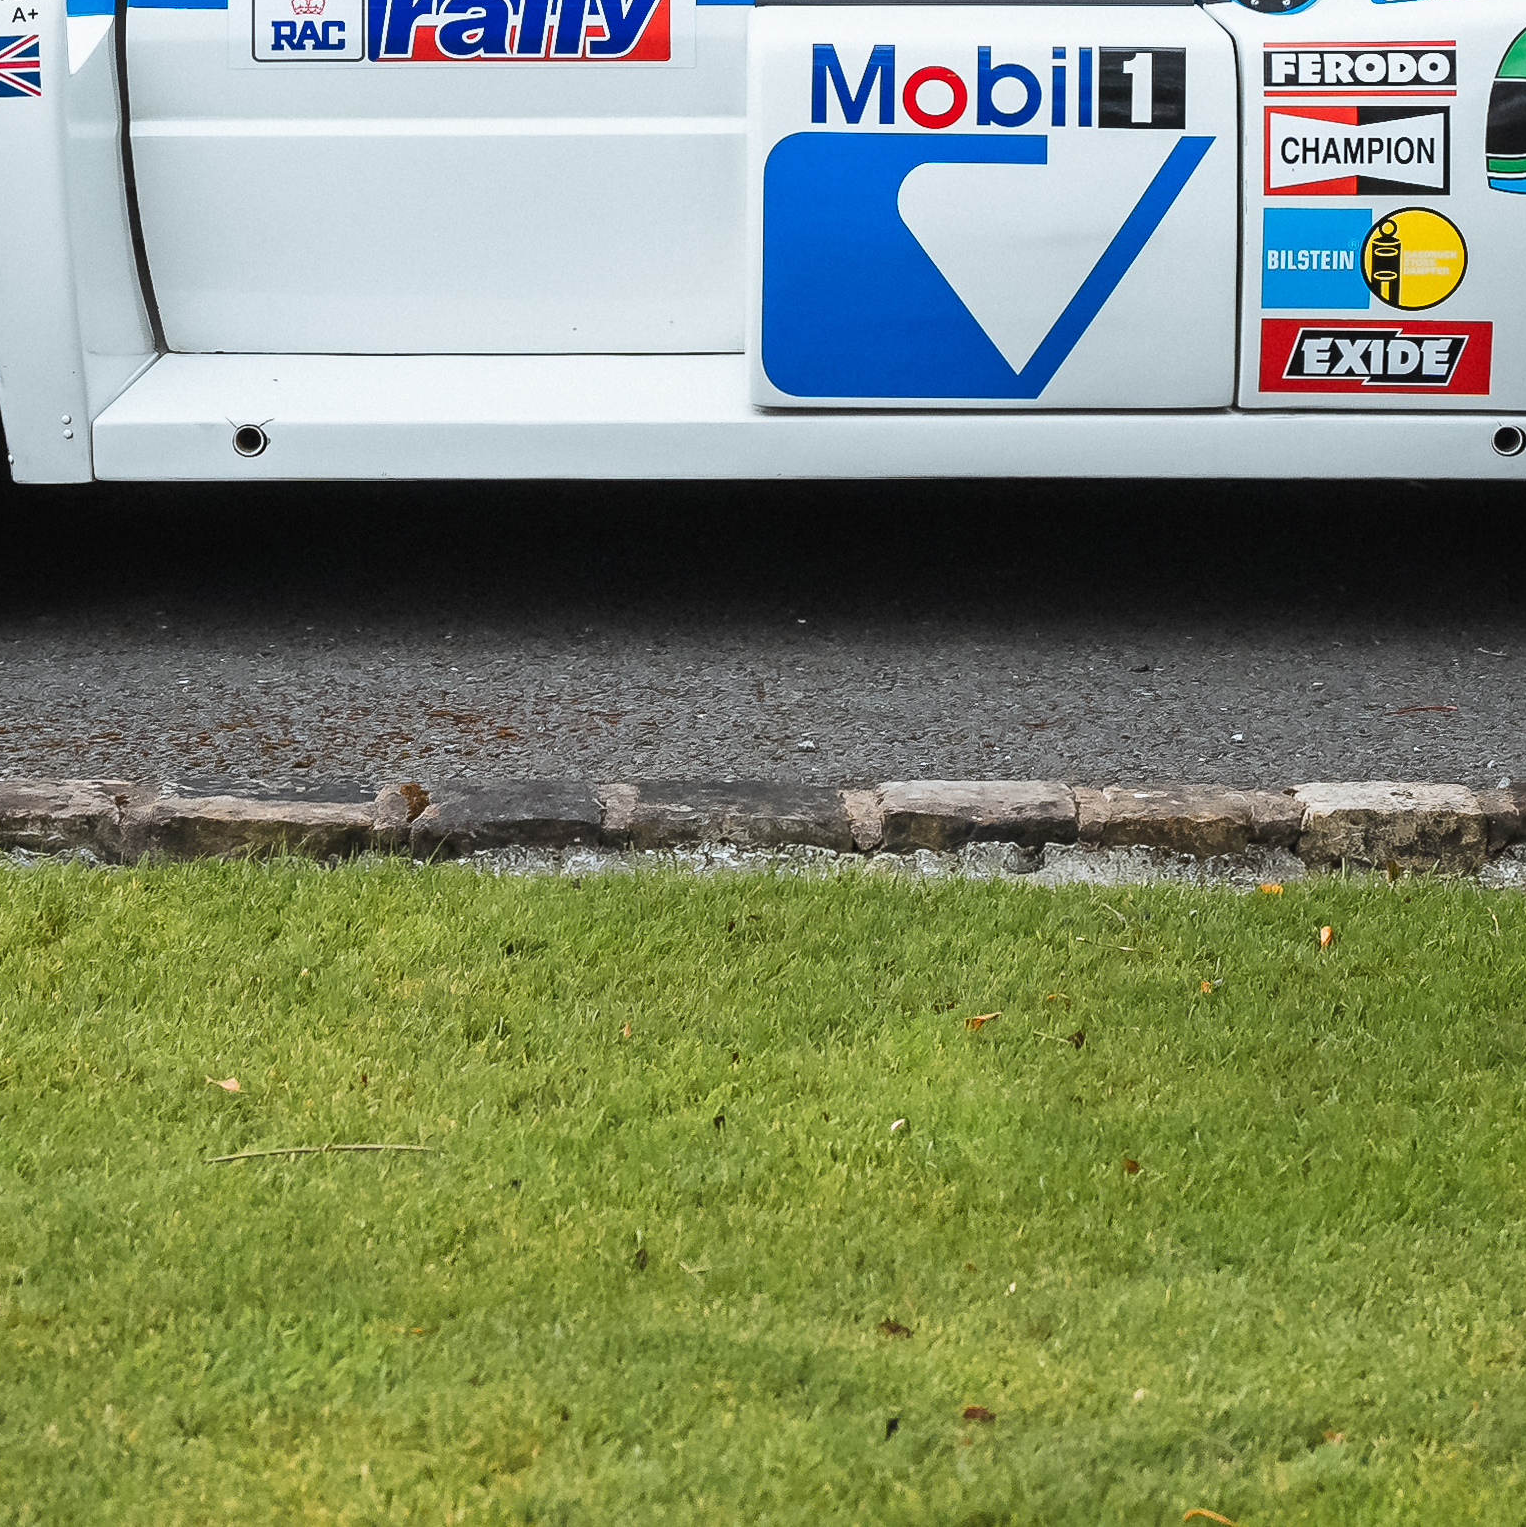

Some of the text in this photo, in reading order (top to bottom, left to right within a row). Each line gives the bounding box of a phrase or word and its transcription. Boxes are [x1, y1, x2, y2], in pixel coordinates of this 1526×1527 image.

[11, 7, 39, 23] A+
[271, 21, 346, 51] RAC
[1270, 52, 1451, 84] FERODO
[811, 44, 1154, 129] Mobil 1
[1280, 136, 1435, 165] CHAMPION
[1267, 249, 1355, 271] BILSTEIN
[1301, 337, 1454, 376] EXIDE
